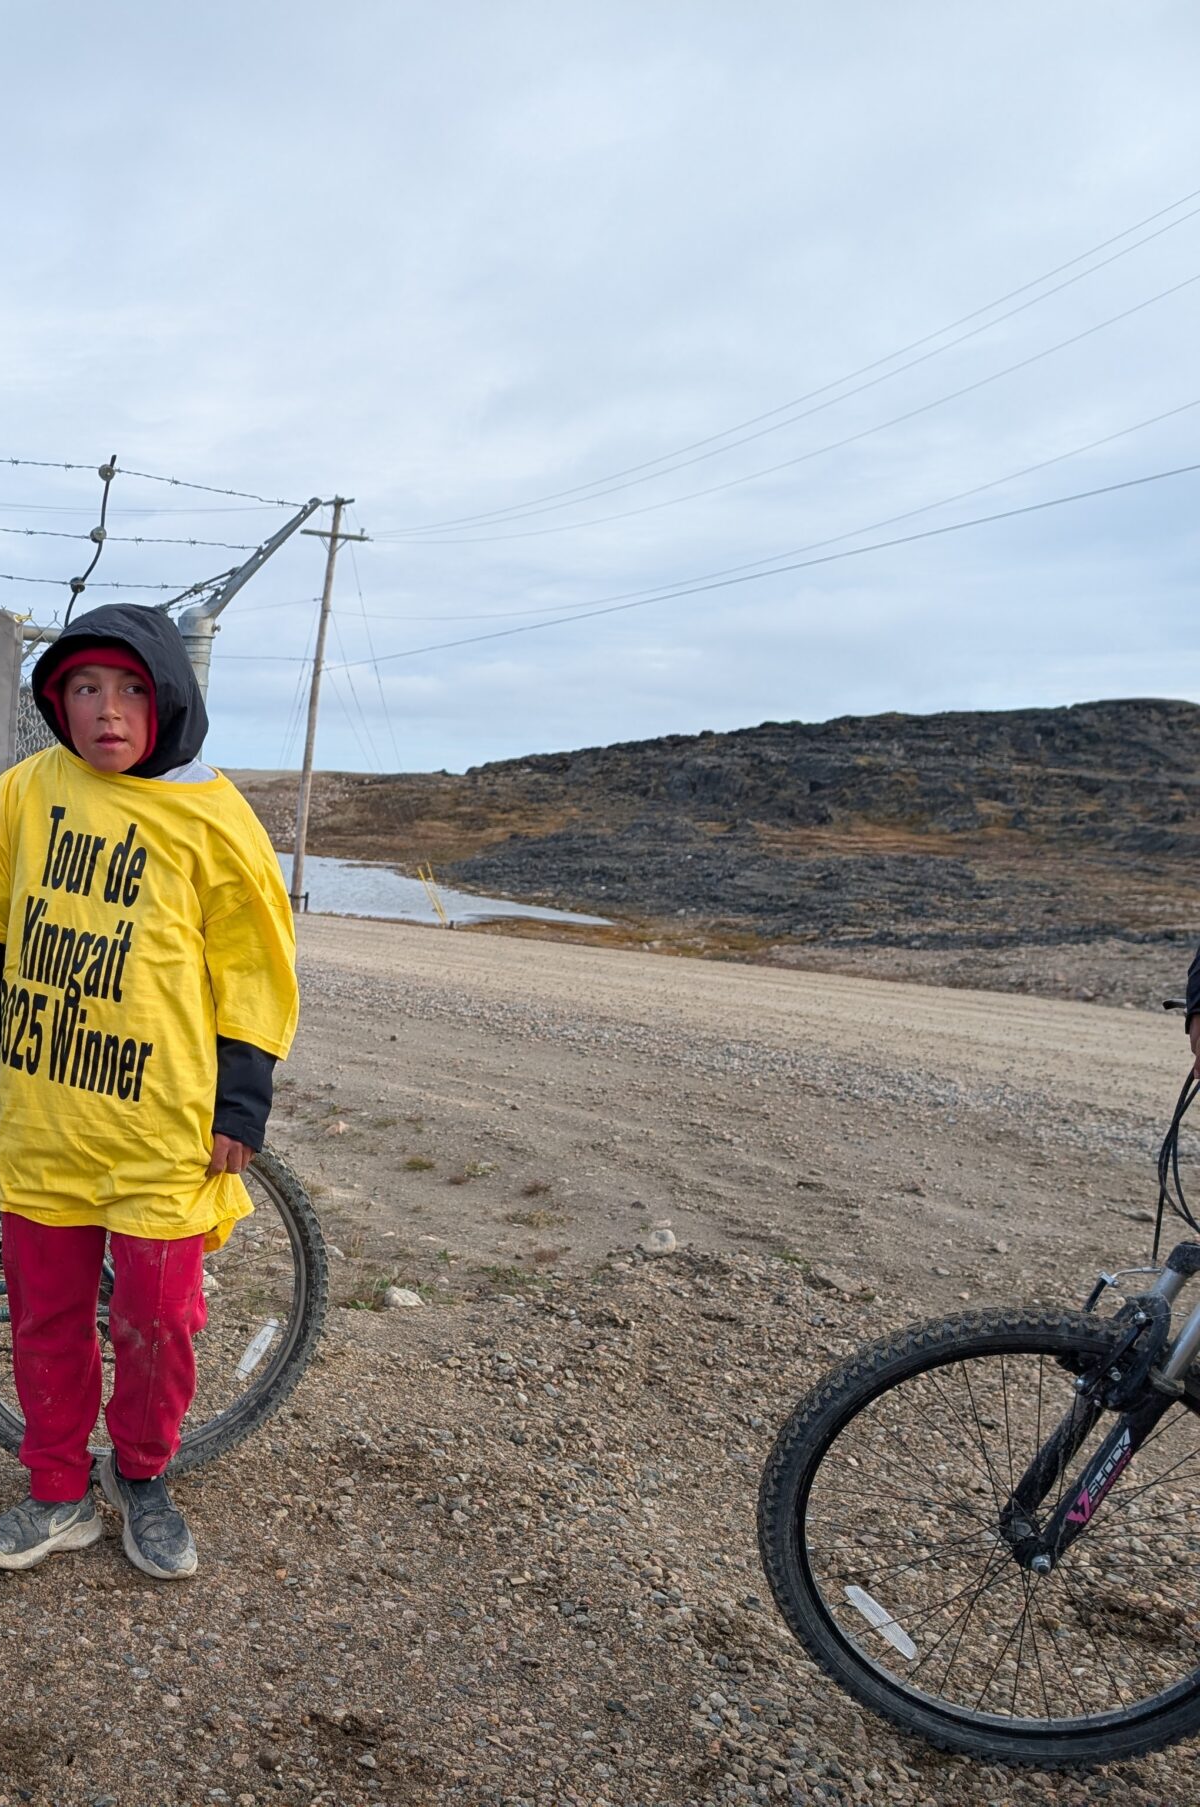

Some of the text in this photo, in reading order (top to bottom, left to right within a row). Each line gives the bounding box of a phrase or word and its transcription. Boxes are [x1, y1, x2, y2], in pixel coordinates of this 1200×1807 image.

[41, 805, 147, 908] Tour de
[18, 895, 135, 1006] Kinngait
[48, 998, 153, 1103] Winner
